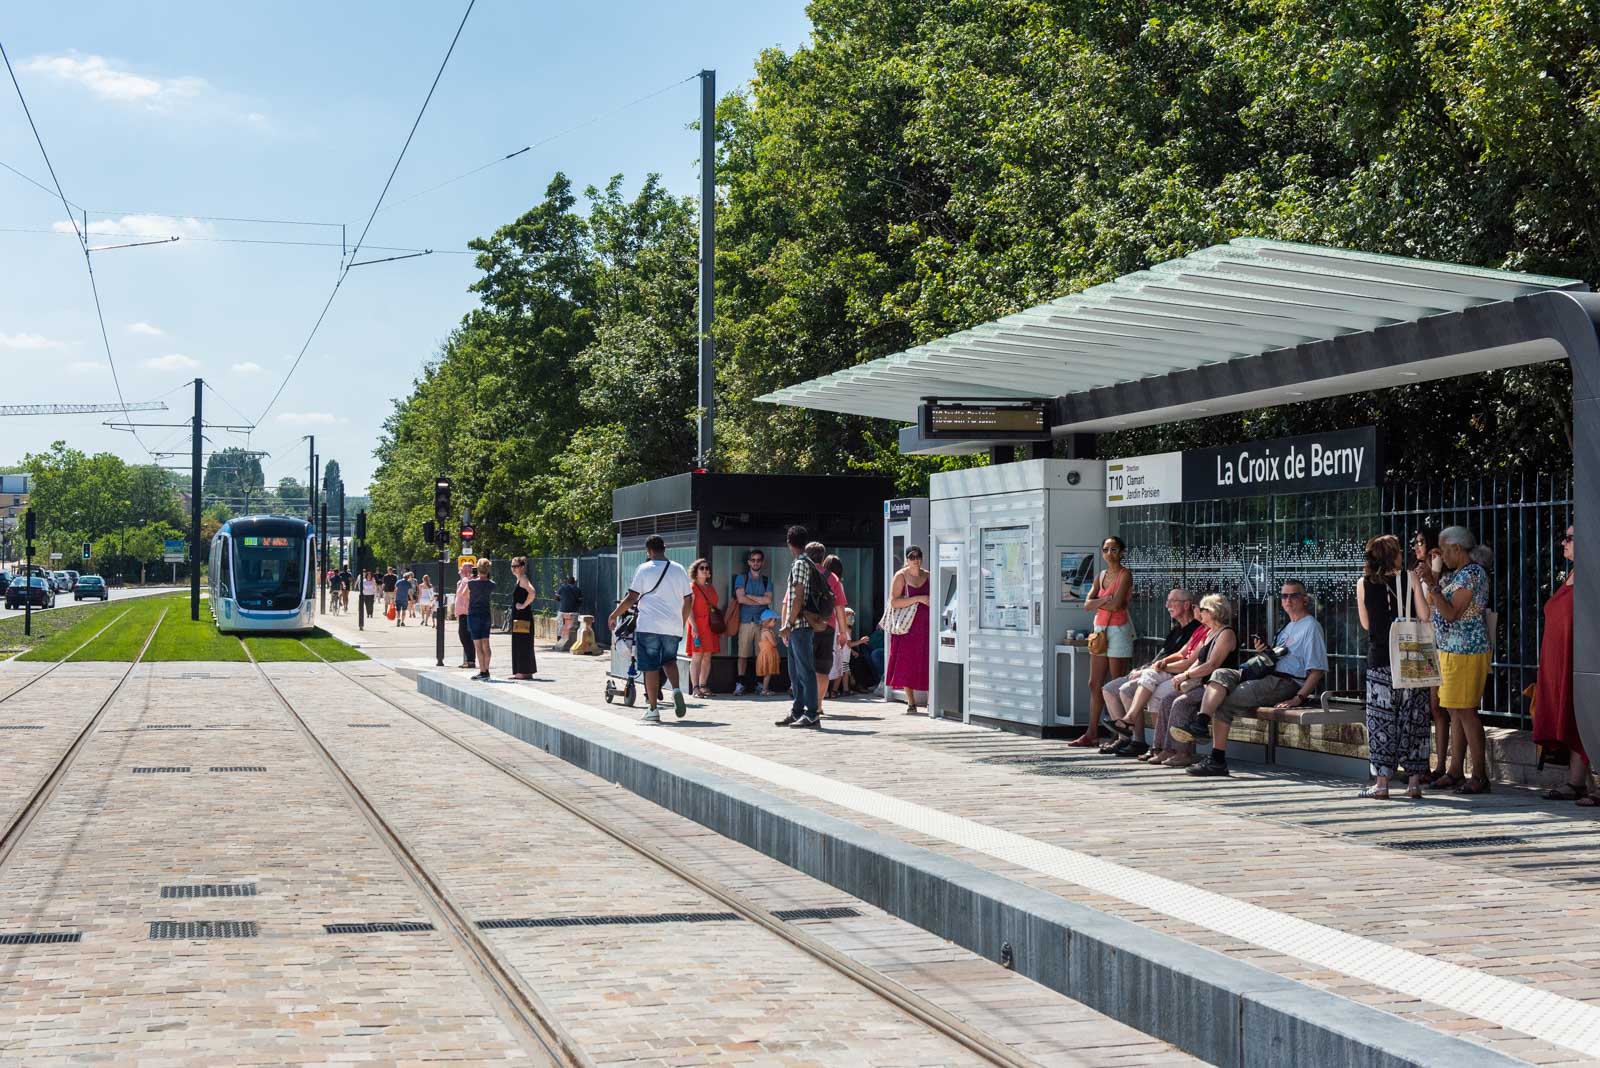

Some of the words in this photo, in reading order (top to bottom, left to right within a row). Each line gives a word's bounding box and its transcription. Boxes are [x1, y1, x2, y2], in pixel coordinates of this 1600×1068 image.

[1217, 455, 1233, 485] La
[1238, 449, 1279, 484] Croix
[1284, 445, 1305, 480] de
[1311, 443, 1364, 482] Berny
[1109, 475, 1123, 491] T10
[1127, 475, 1145, 485] Clamart
[1126, 489, 1140, 499] Jardin
[1141, 487, 1160, 498] Parisien
